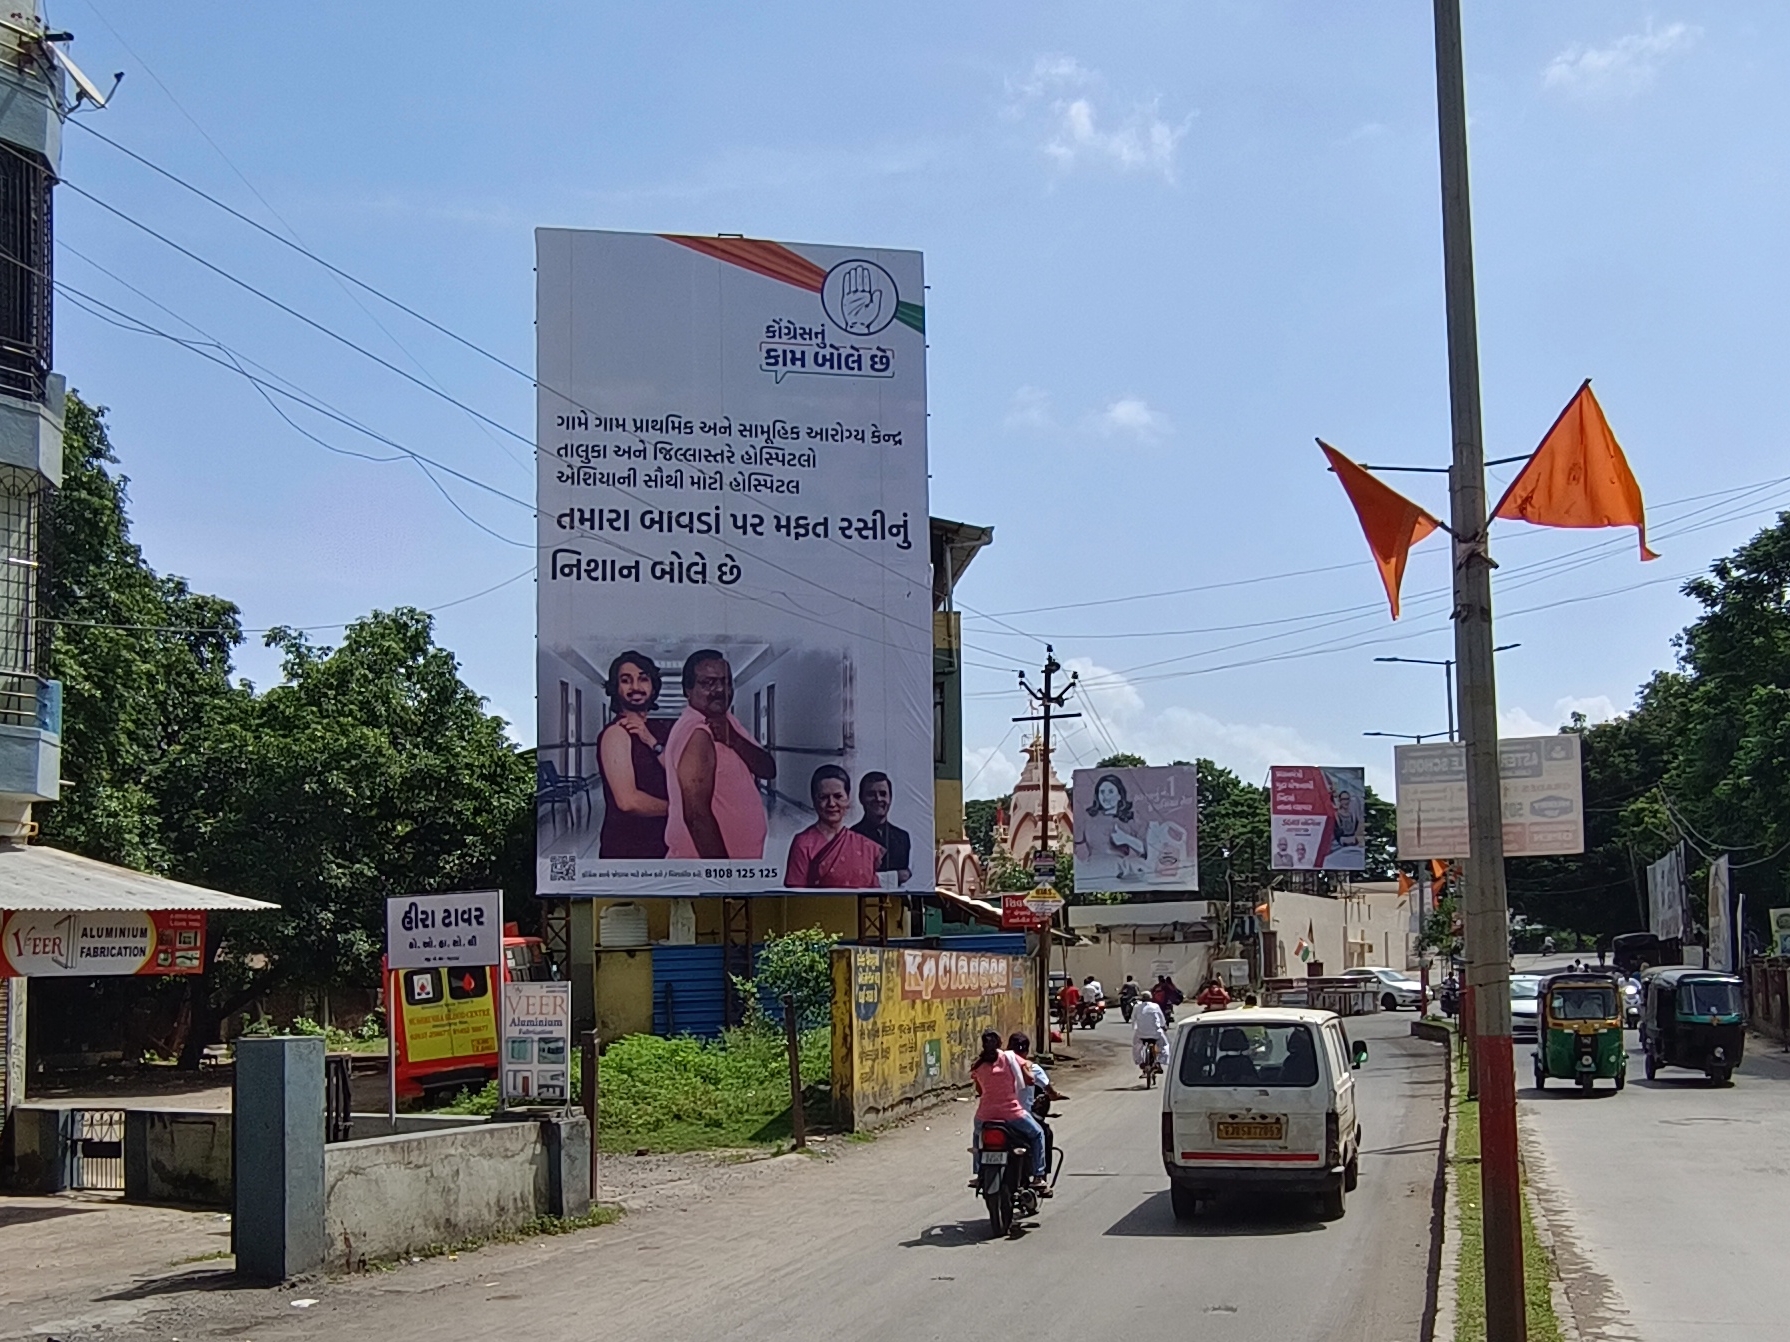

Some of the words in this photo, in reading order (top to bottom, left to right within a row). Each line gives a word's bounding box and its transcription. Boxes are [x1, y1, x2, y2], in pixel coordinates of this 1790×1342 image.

[764, 348, 806, 368] કામ
[813, 343, 863, 372] બોલે
[869, 346, 891, 373] છે
[556, 410, 588, 431] ગામે
[594, 416, 626, 432] ગામ
[633, 414, 694, 435] પ્રાથમિક
[699, 416, 732, 436] અને
[738, 420, 801, 445] સામૂહિક
[806, 422, 865, 443] આરોગ્ય
[870, 424, 902, 446] કેન્દ્ર
[556, 443, 607, 464] તાલુકા
[613, 440, 647, 460] અને
[653, 441, 736, 464] જિલ્લાસ્તરે
[741, 445, 816, 468] હોસ્પિટલો
[556, 465, 637, 487] એશિયાની
[643, 466, 684, 489] સૌથી
[729, 471, 800, 494] હોસ્પિટલ
[556, 508, 630, 532] તમારા
[640, 506, 720, 534] બાવડાં
[730, 514, 765, 536] પર
[773, 515, 830, 540] મફત
[838, 509, 912, 550] રસીનું
[551, 548, 640, 582] નિશાન
[650, 551, 707, 584] બોલે
[717, 553, 742, 585] છે
[705, 868, 733, 879] 8108
[736, 868, 757, 879] 125
[758, 868, 778, 879] 125
[401, 901, 436, 931] હીરા
[441, 906, 485, 927] ટાવર
[12, 925, 64, 957] VEER
[80, 926, 148, 939] ALUMINIUM
[79, 945, 147, 958] FABRICATION
[505, 995, 567, 1016] VEER
[508, 1016, 563, 1027] Aluminium
